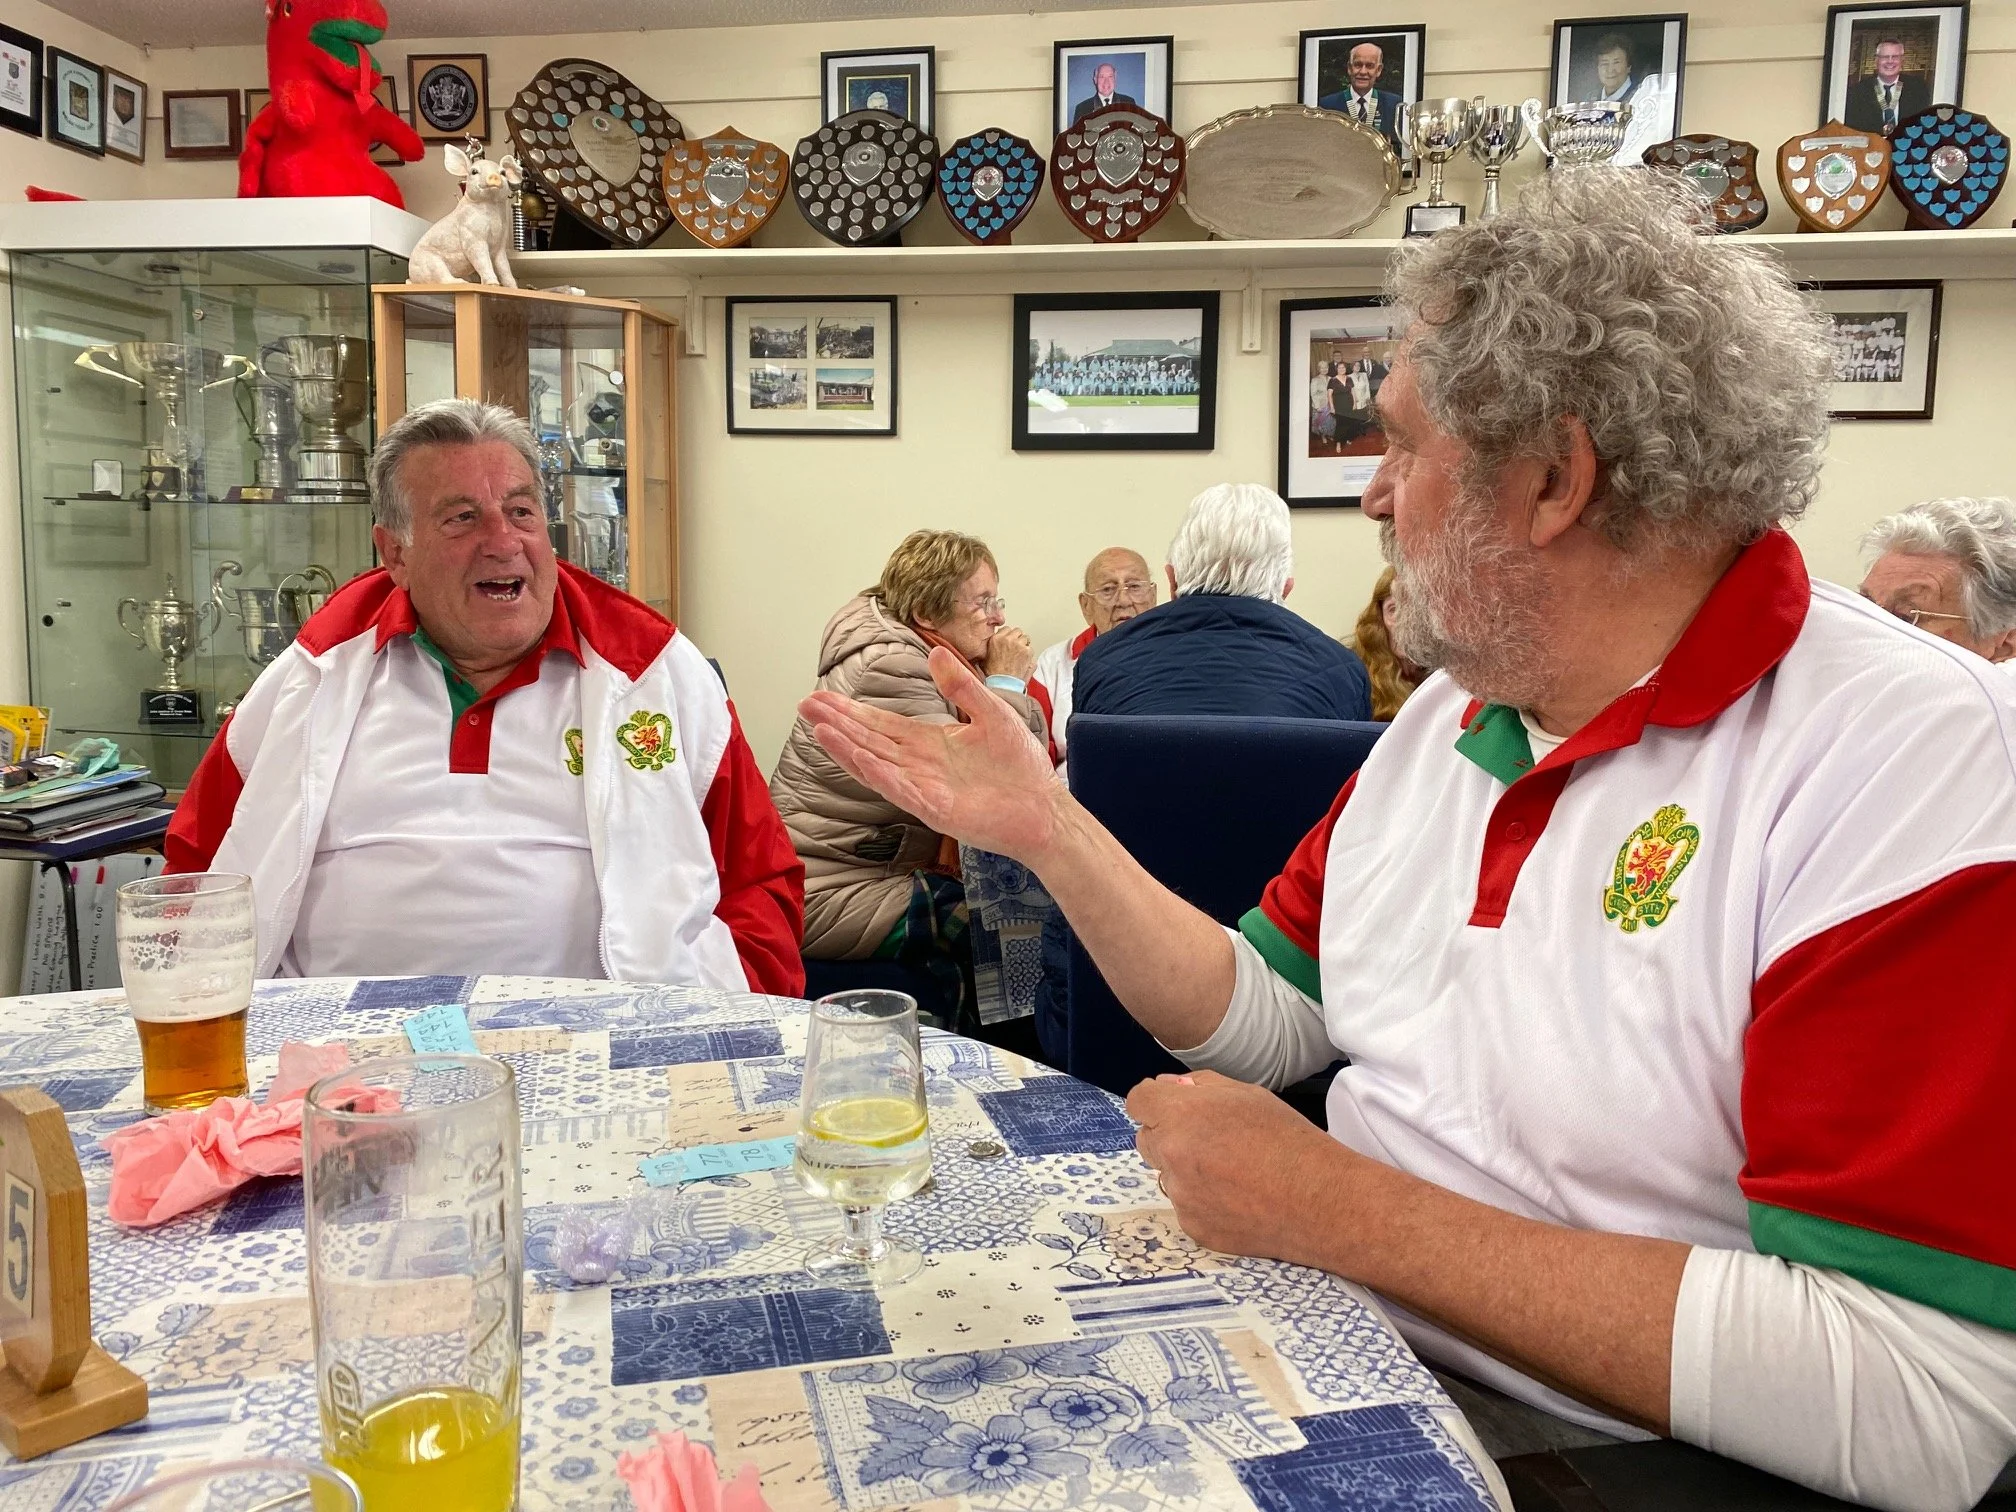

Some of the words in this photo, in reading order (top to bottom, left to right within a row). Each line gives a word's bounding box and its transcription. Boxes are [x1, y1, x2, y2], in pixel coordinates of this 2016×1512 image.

[698, 1152, 721, 1167] 77
[741, 1148, 765, 1163] 78
[7, 1183, 29, 1301] 5
